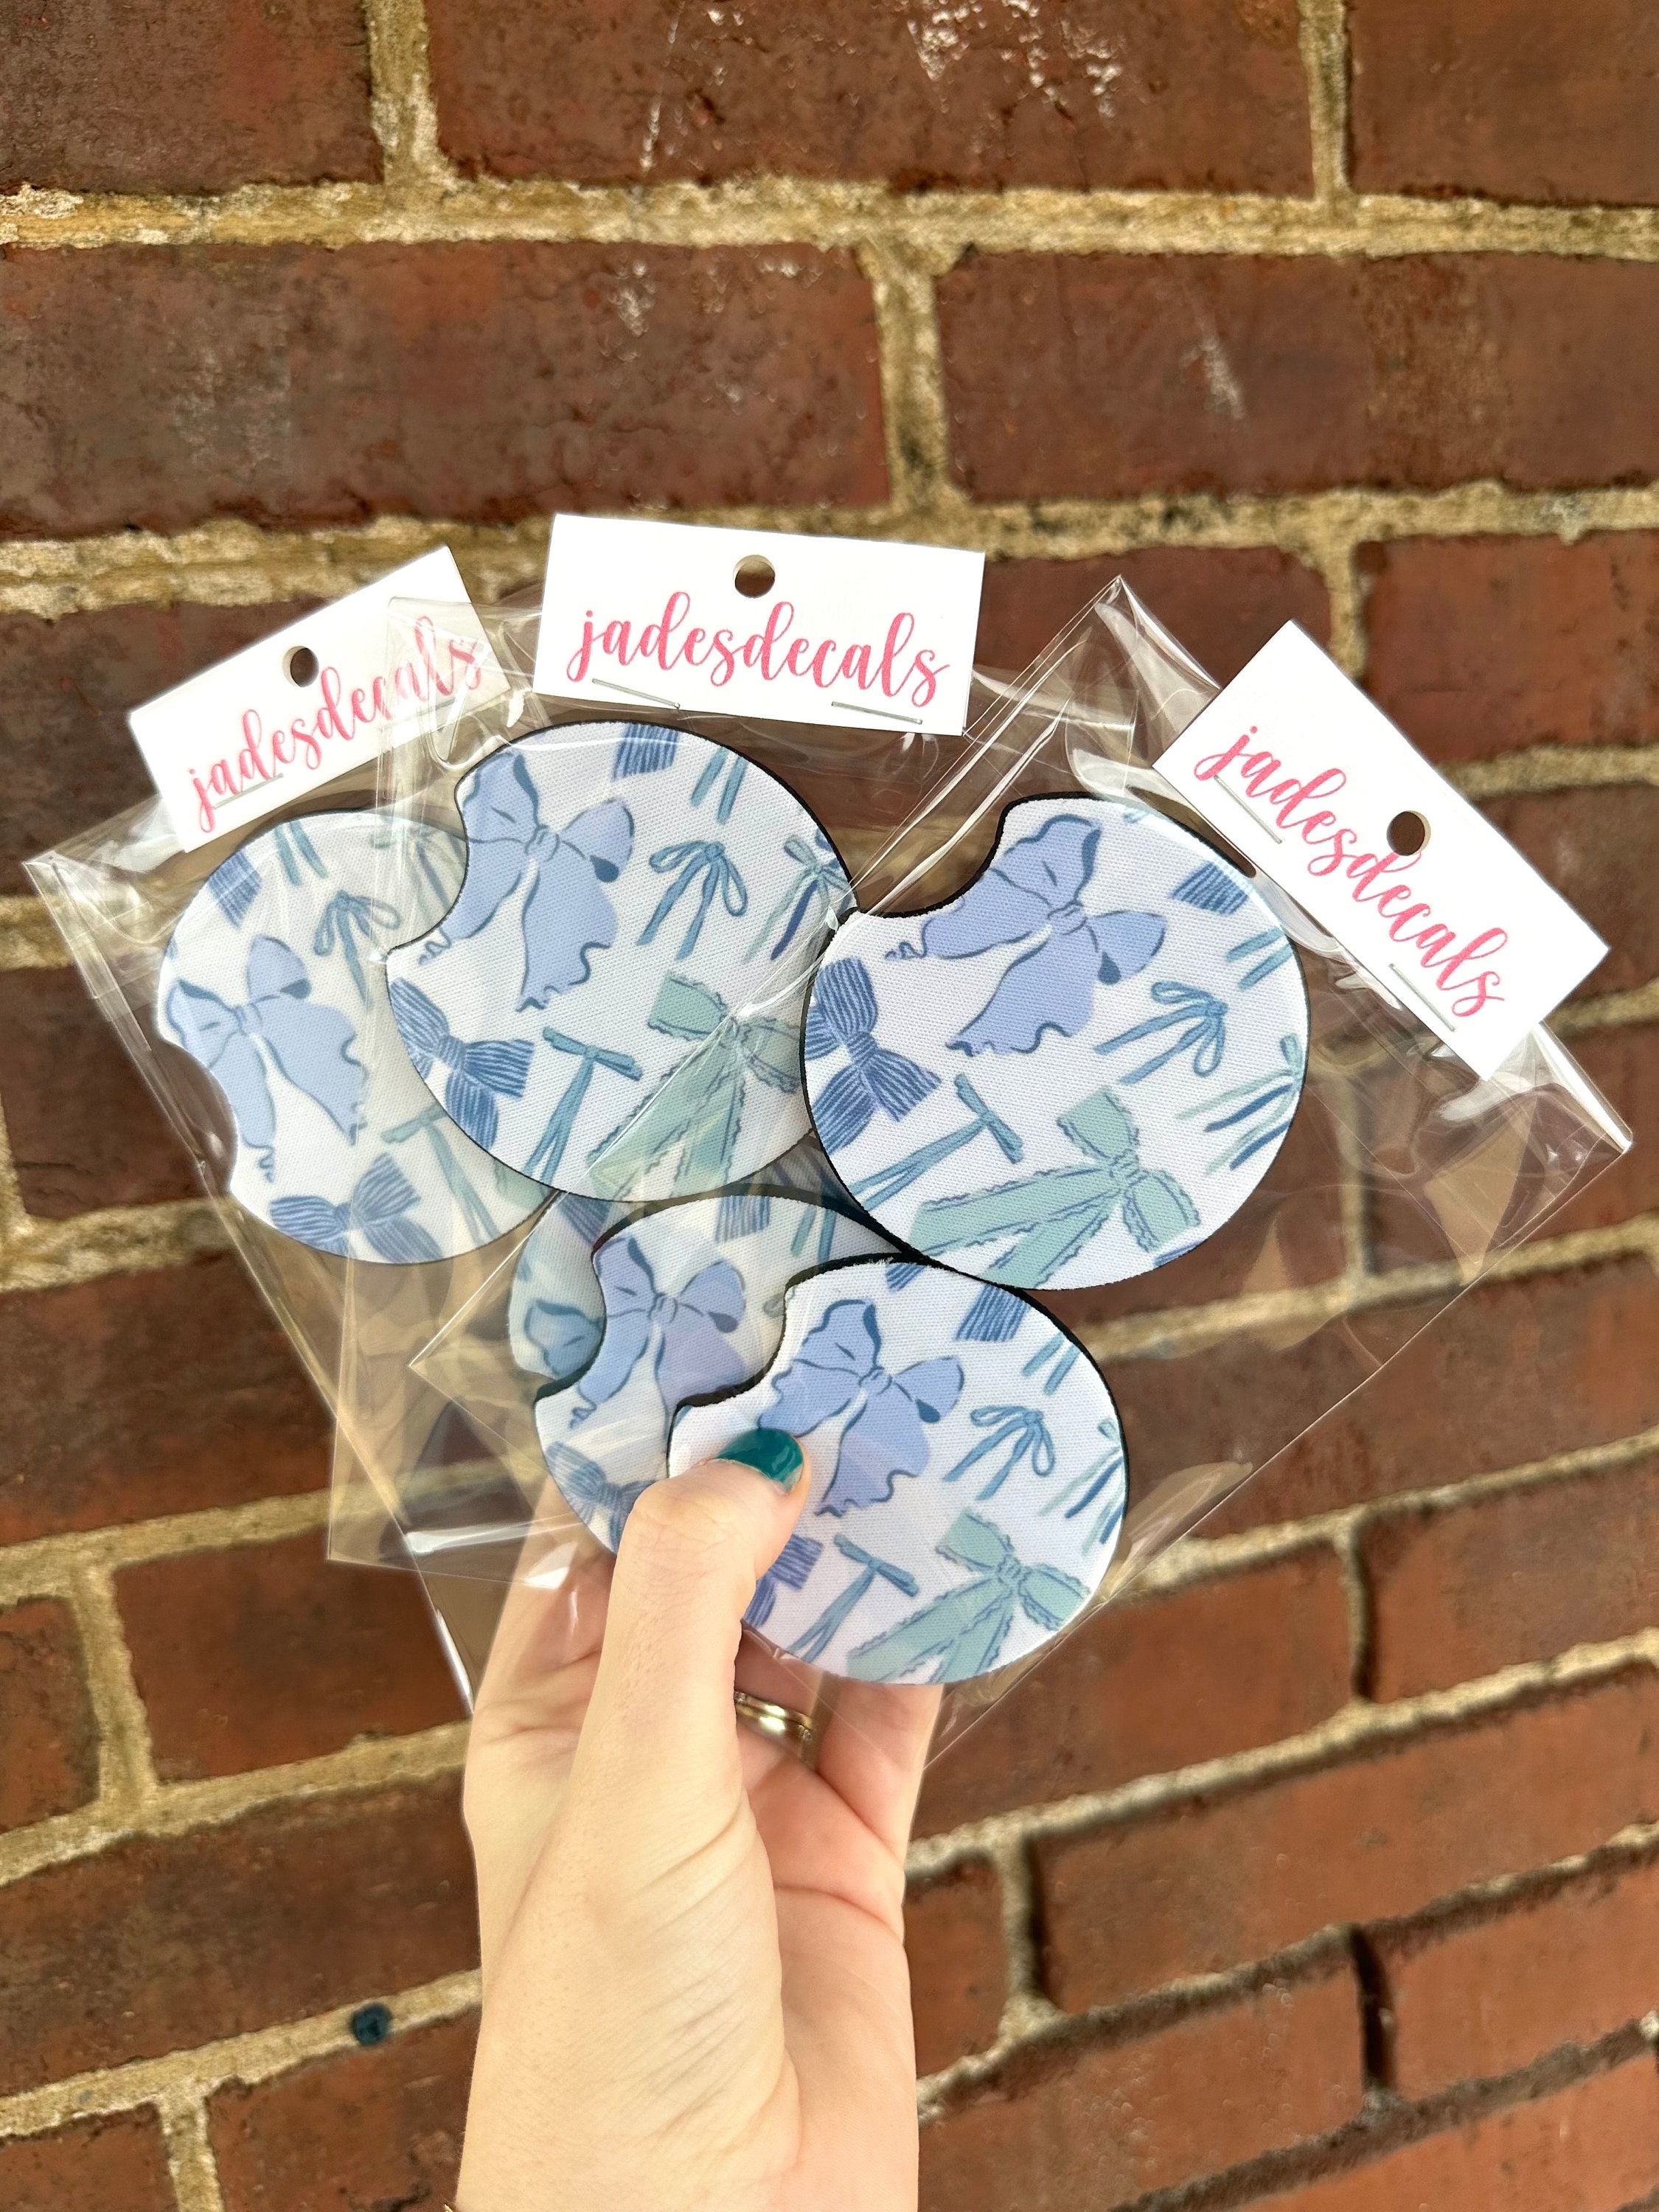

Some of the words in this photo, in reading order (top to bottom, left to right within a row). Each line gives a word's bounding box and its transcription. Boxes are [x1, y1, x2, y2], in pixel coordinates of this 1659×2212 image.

[188, 616, 482, 834] jadesdecals
[566, 591, 950, 708] jadesdecals
[1193, 726, 1509, 1018] jadesdecals
